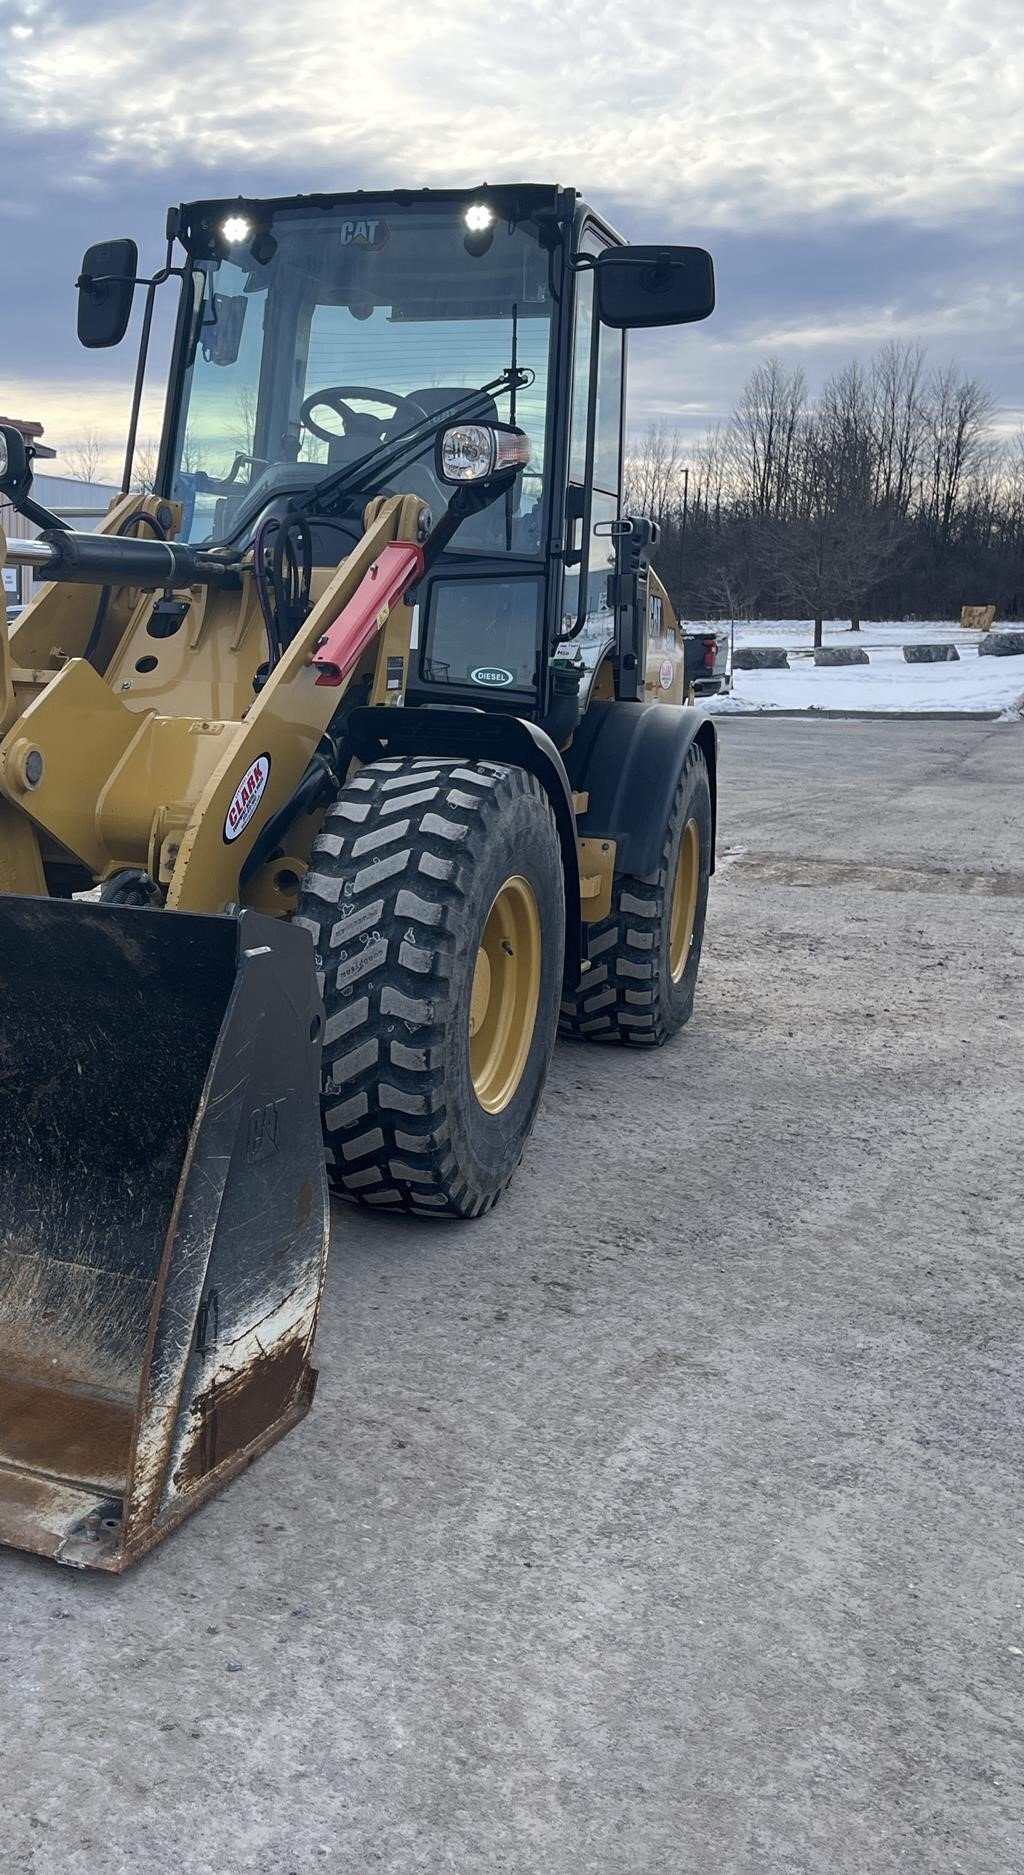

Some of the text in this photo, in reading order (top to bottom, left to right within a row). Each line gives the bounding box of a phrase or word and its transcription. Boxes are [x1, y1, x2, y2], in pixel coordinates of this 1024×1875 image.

[340, 220, 379, 246] CAT
[477, 672, 506, 682] DIESEL
[228, 761, 264, 828] CLARK
